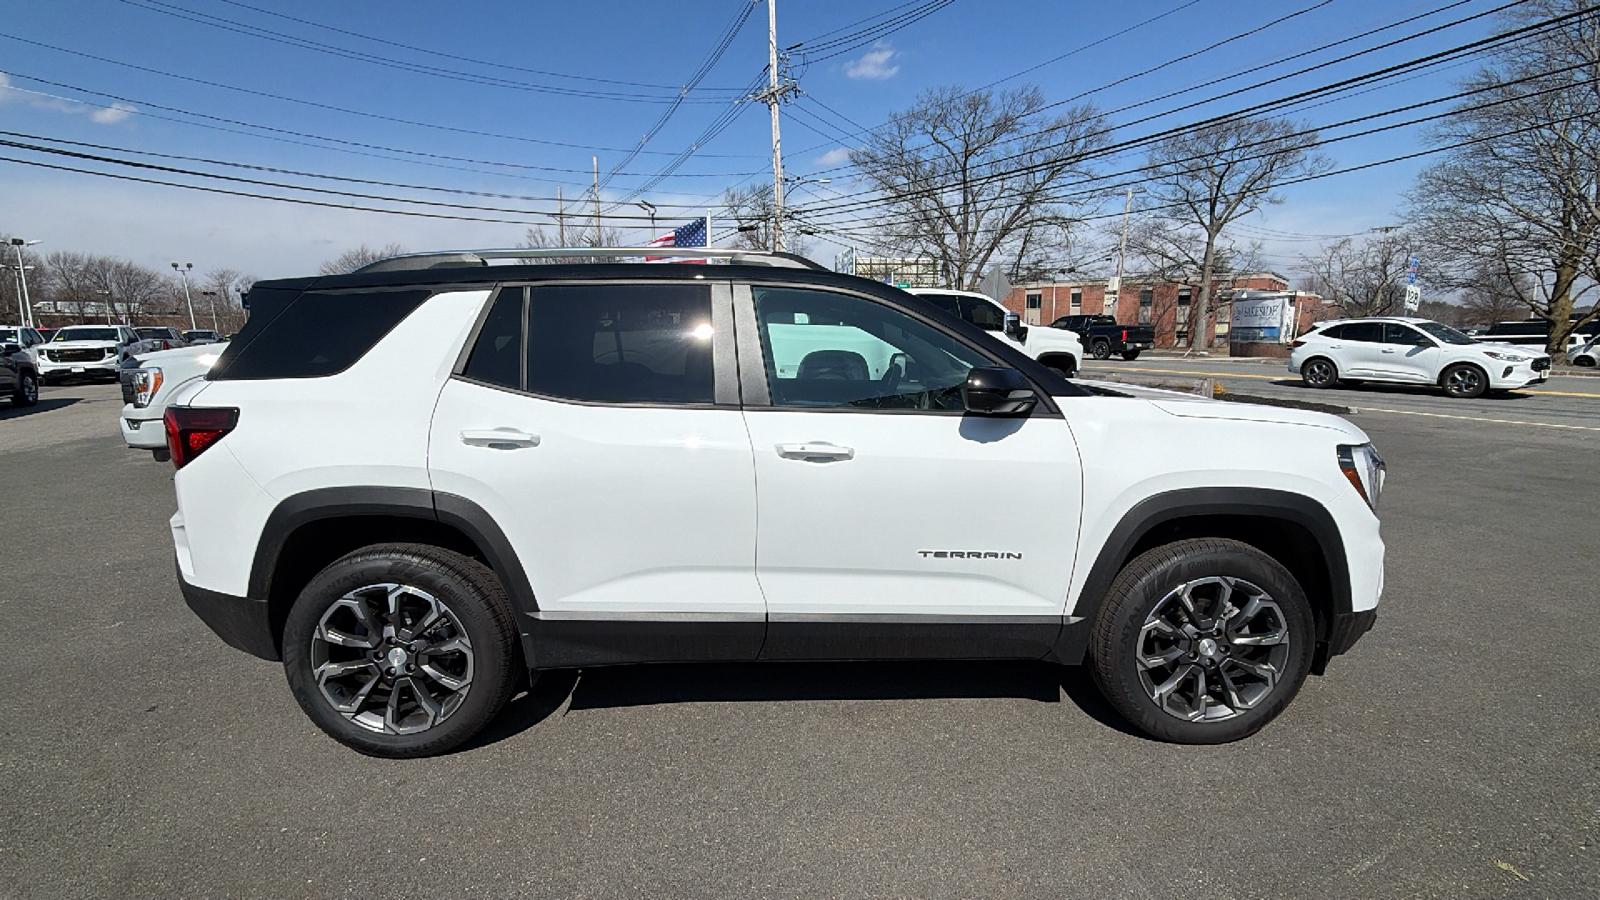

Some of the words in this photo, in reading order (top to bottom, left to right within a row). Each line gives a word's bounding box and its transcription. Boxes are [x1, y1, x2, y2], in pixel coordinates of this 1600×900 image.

[1407, 290, 1418, 306] 128
[1243, 305, 1279, 317] LAKESIDE
[918, 550, 1022, 560] TERRAIN
